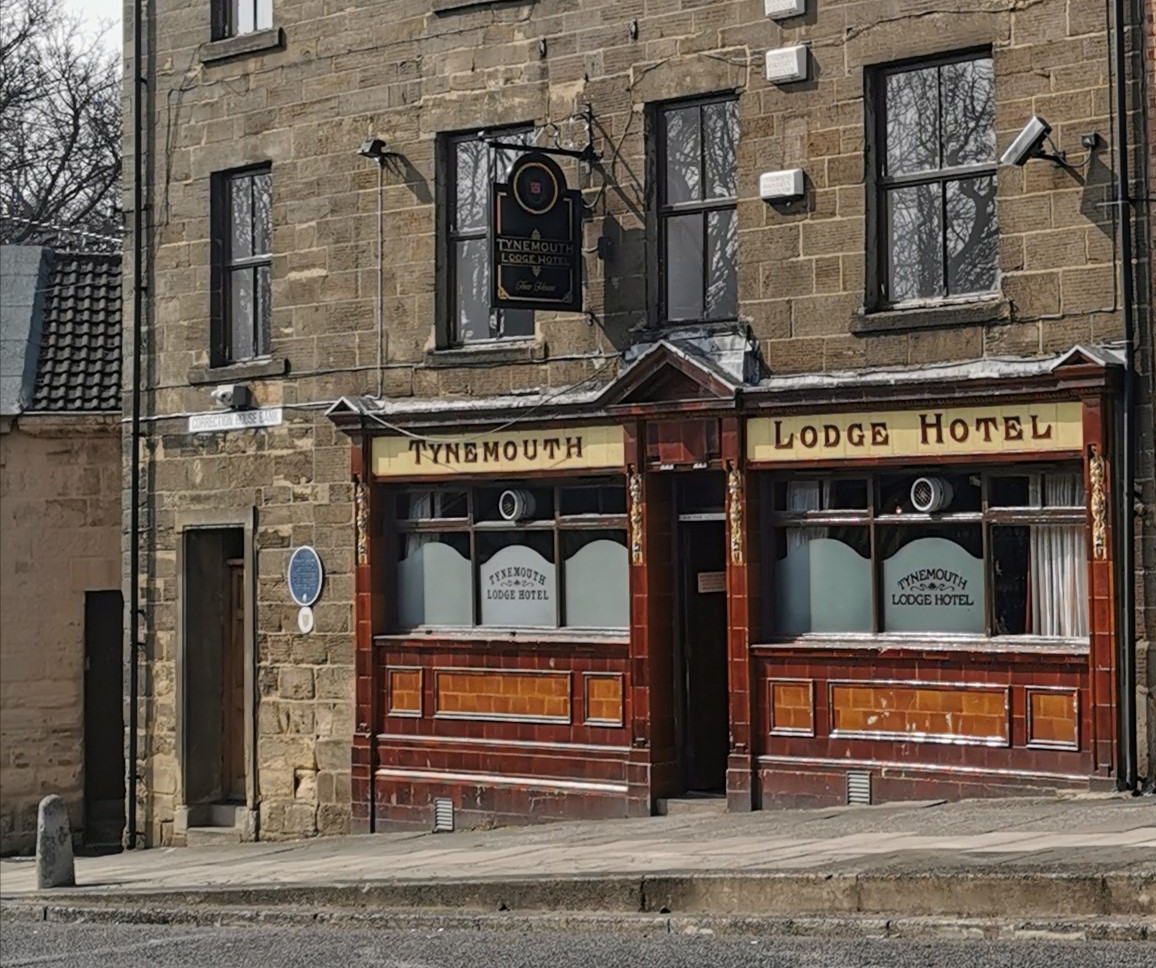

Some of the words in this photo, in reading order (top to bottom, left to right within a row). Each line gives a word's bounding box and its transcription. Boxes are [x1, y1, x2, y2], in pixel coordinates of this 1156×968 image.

[496, 238, 574, 253] TYNEMOUTH
[501, 252, 537, 264] LODGE
[538, 254, 571, 265] HOTEL
[191, 414, 233, 429] CORRECTION
[773, 420, 890, 450] LODGE
[919, 412, 1052, 445] HOTEL
[408, 435, 583, 466] TYNEMOUTH
[489, 566, 546, 586] TYNEMOUTH
[897, 568, 968, 590] TYNEMOUTH
[487, 589, 516, 600] LODGE
[518, 589, 549, 600] HOTEL
[892, 593, 932, 606] LODGE
[934, 593, 975, 606] HOTEL
